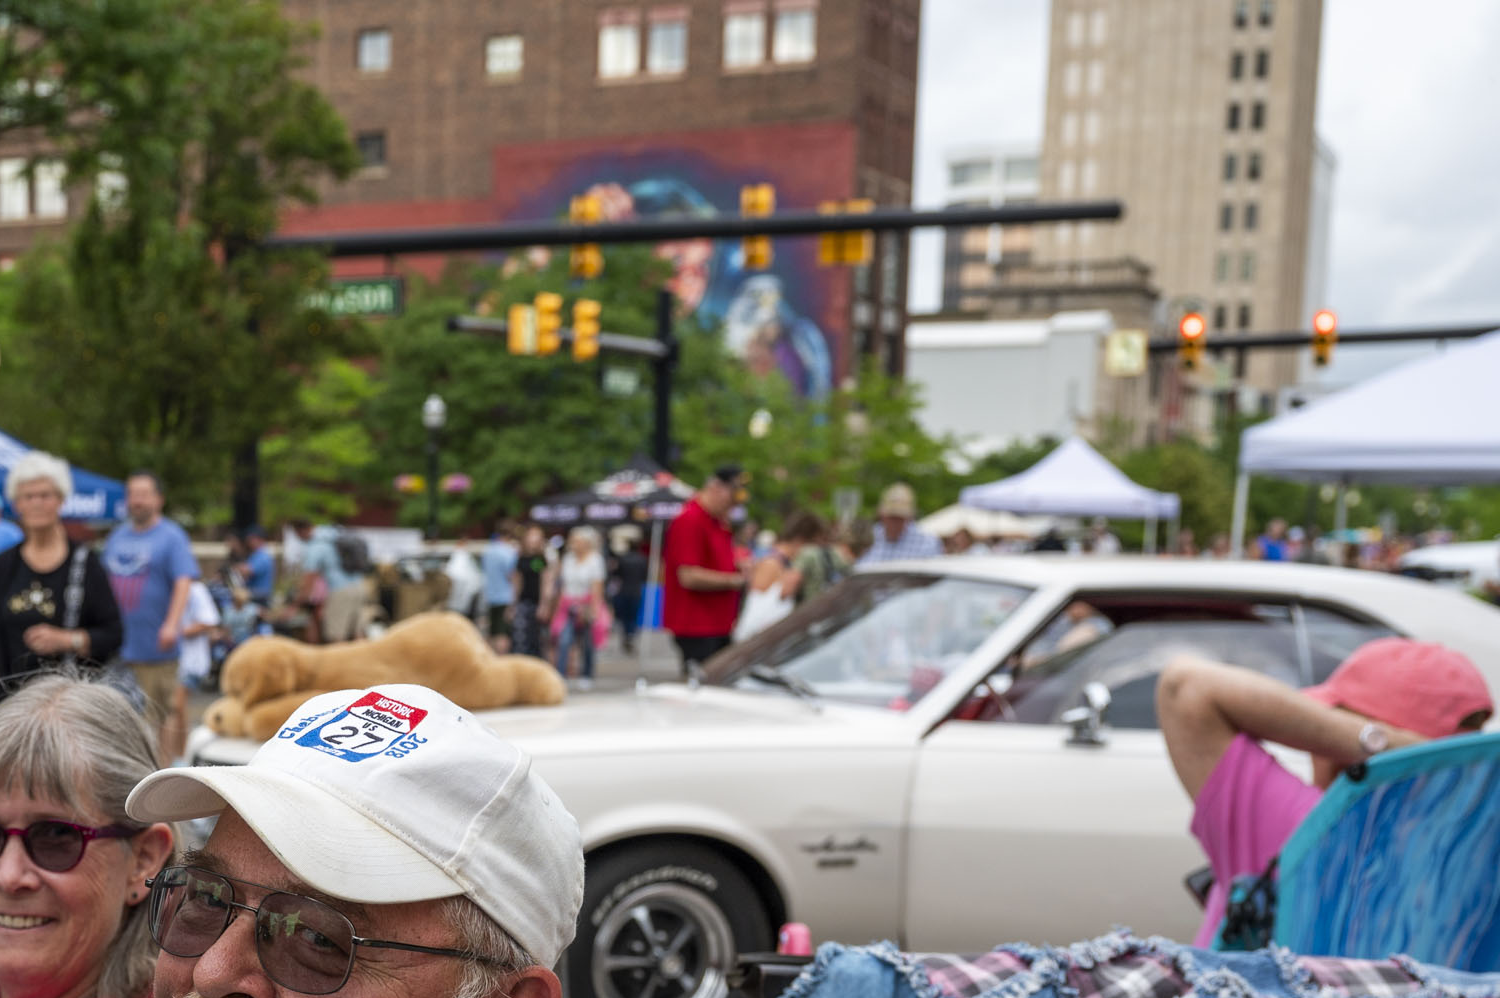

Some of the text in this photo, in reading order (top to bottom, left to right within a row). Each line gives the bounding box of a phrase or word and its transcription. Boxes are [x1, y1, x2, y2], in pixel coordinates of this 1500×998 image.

[362, 708, 404, 729] MICHIGAN
[375, 697, 415, 718] HISTORIC
[323, 726, 384, 749] 27
[384, 733, 428, 758] 2018
